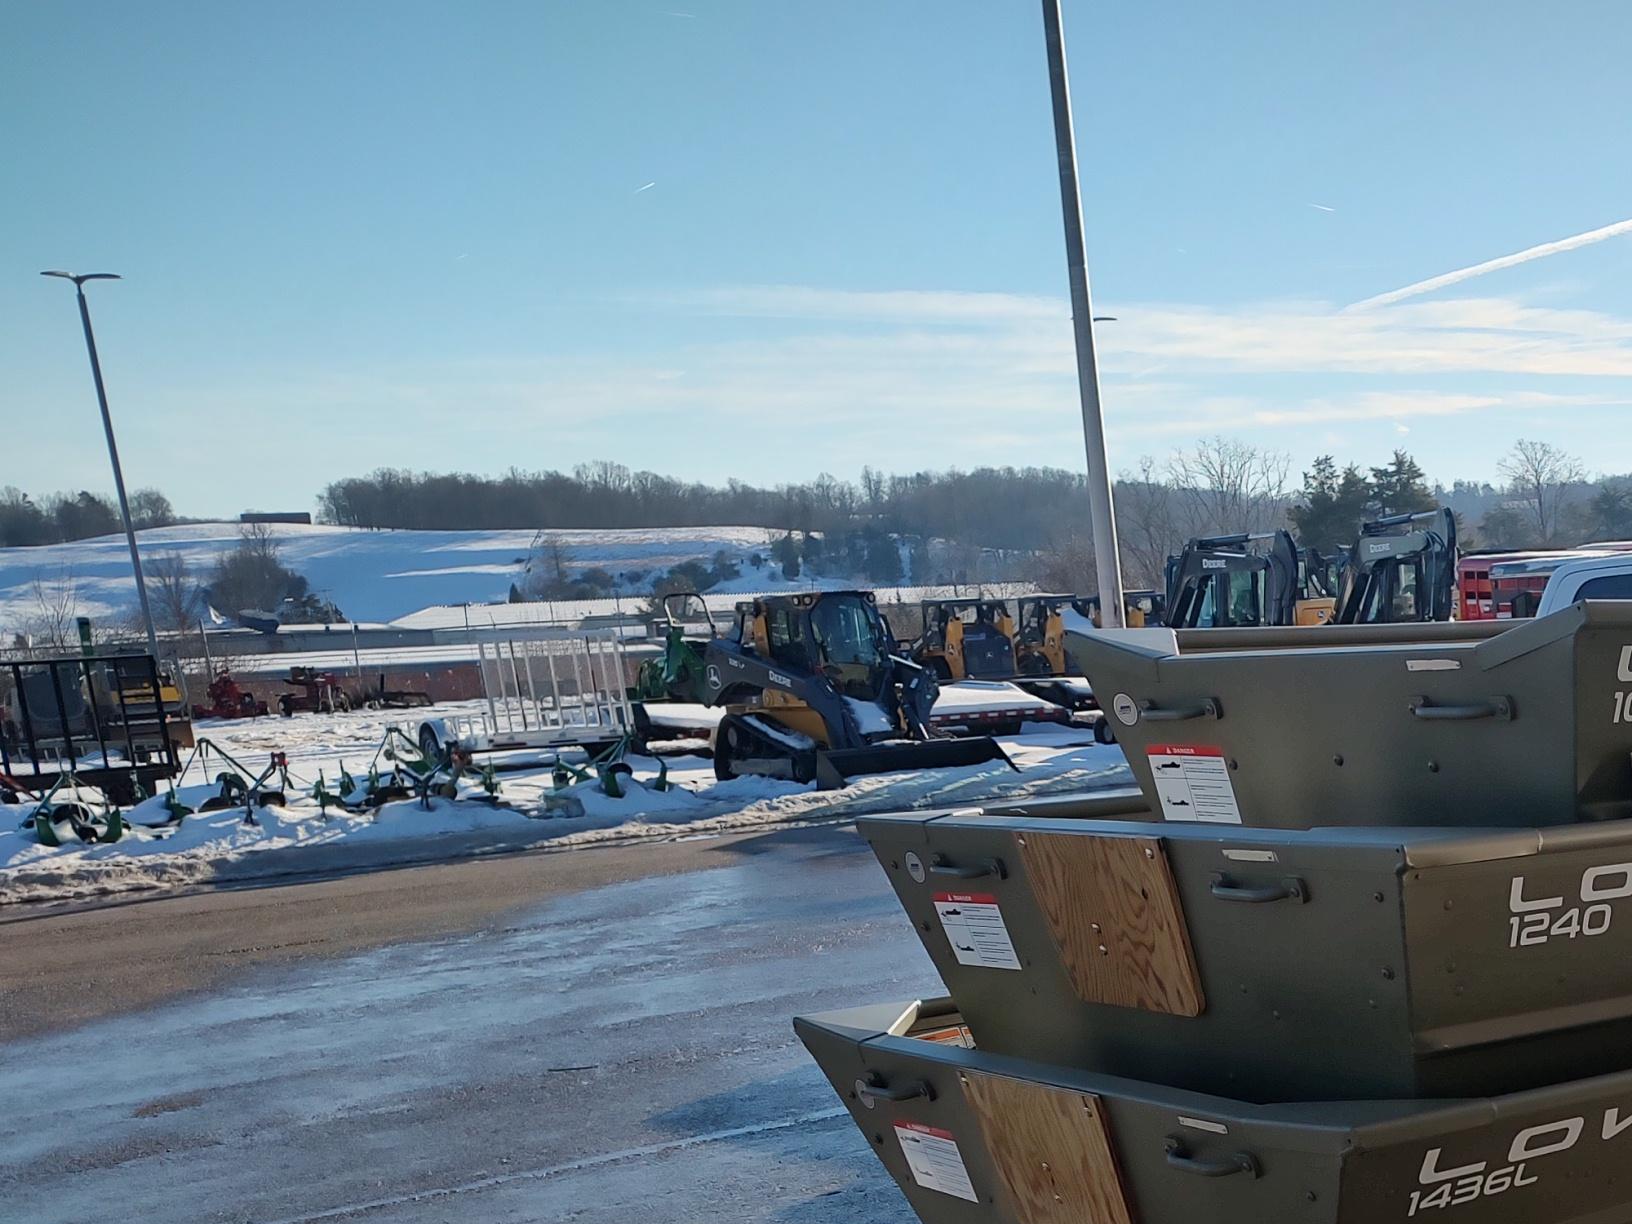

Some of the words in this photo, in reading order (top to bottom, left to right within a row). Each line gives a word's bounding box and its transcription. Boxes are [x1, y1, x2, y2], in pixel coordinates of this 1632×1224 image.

[1202, 558, 1227, 569] DEERE
[768, 670, 792, 688] DEERE
[1509, 903, 1613, 948] 1240
[1406, 1162, 1540, 1217] 1436L
